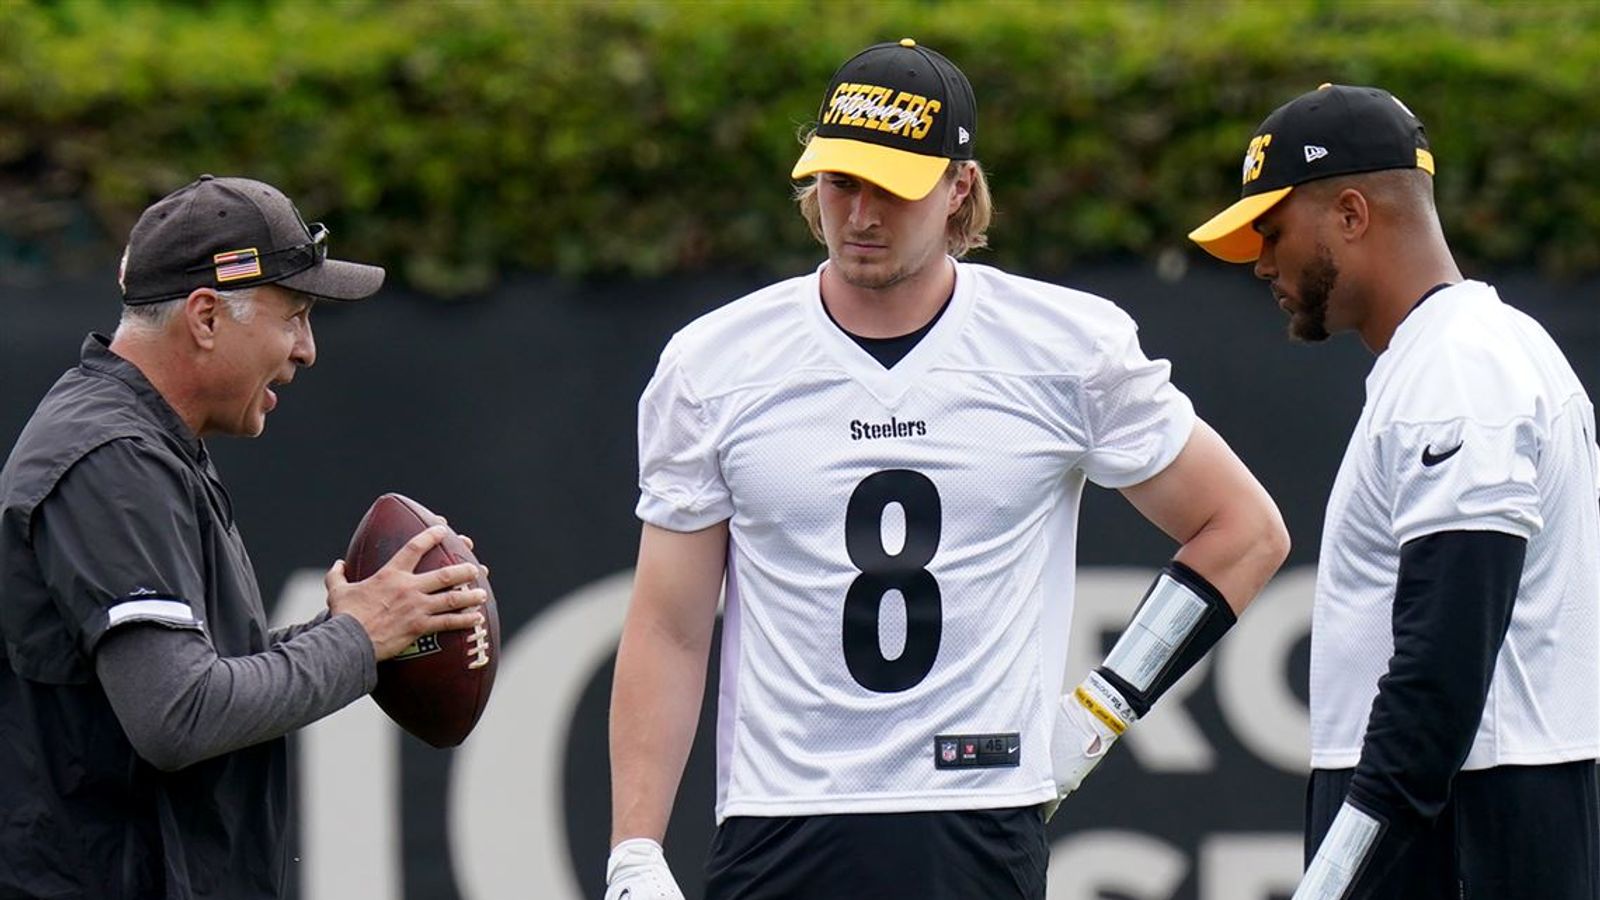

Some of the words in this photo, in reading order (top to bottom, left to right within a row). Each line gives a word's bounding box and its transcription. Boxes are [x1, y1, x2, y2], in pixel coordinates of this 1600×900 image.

[823, 82, 941, 140] STEELERS
[850, 416, 927, 441] Steelers
[842, 468, 943, 693] 8
